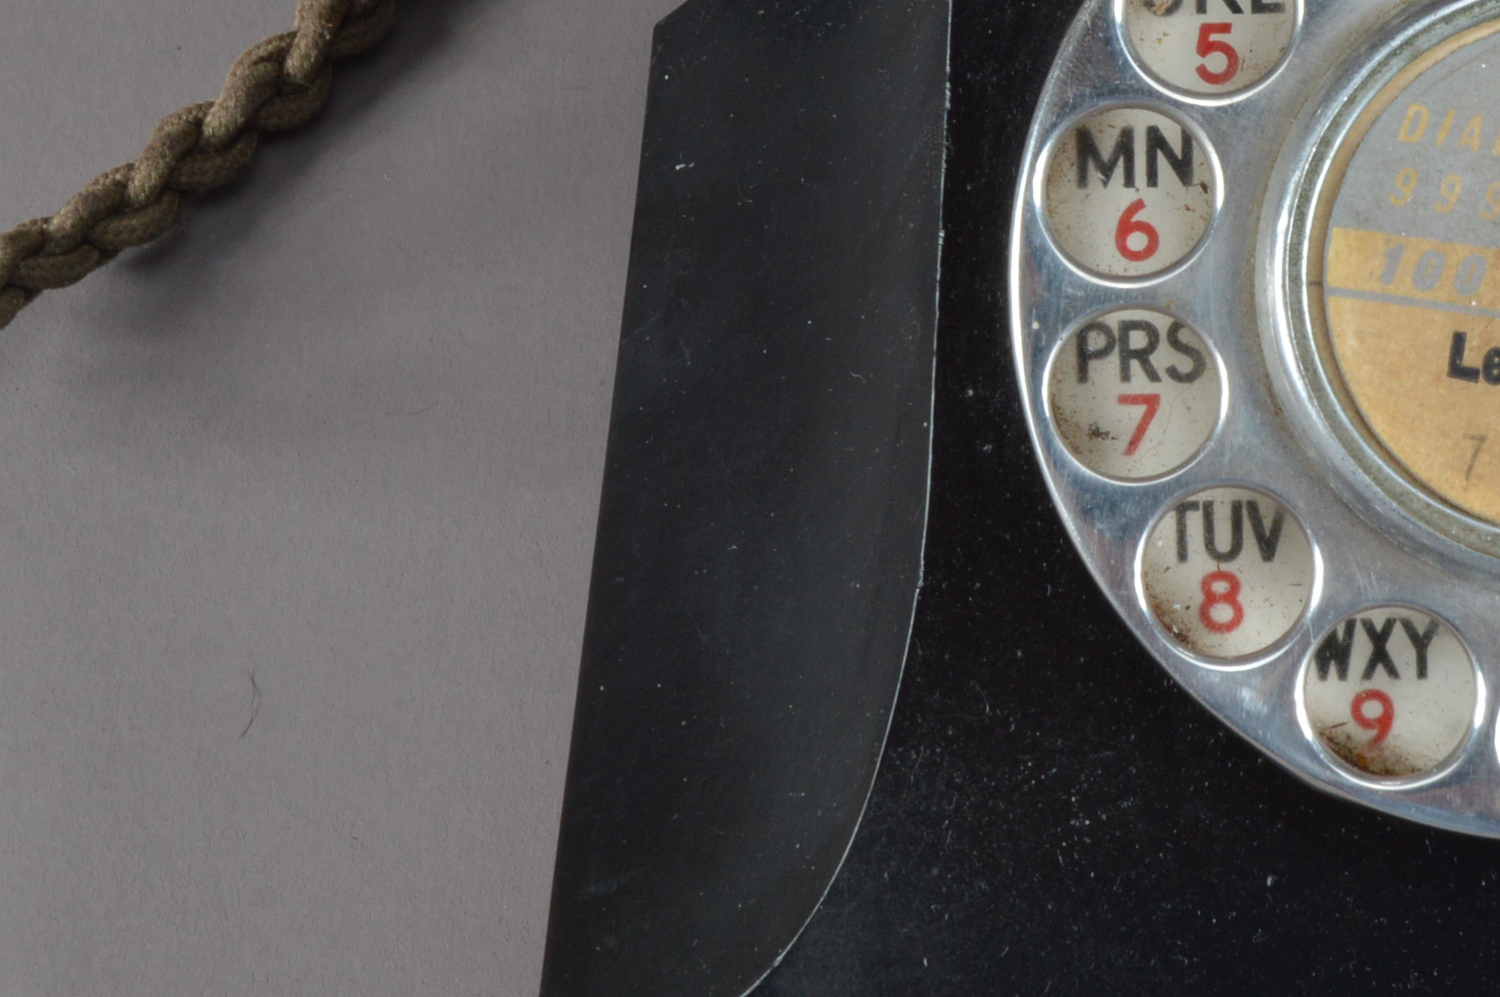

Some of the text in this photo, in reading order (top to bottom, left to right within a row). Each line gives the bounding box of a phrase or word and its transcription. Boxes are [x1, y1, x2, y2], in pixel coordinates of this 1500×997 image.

[1195, 22, 1239, 85] 5
[1075, 125, 1194, 189] MN
[1115, 198, 1160, 262] 6
[1377, 243, 1488, 298] 100
[1075, 319, 1206, 384] PRS
[1117, 392, 1161, 456] 7
[1171, 500, 1283, 562] TUV
[1199, 570, 1244, 633] 8
[1315, 617, 1440, 681] WXY
[1350, 689, 1394, 749] 9
